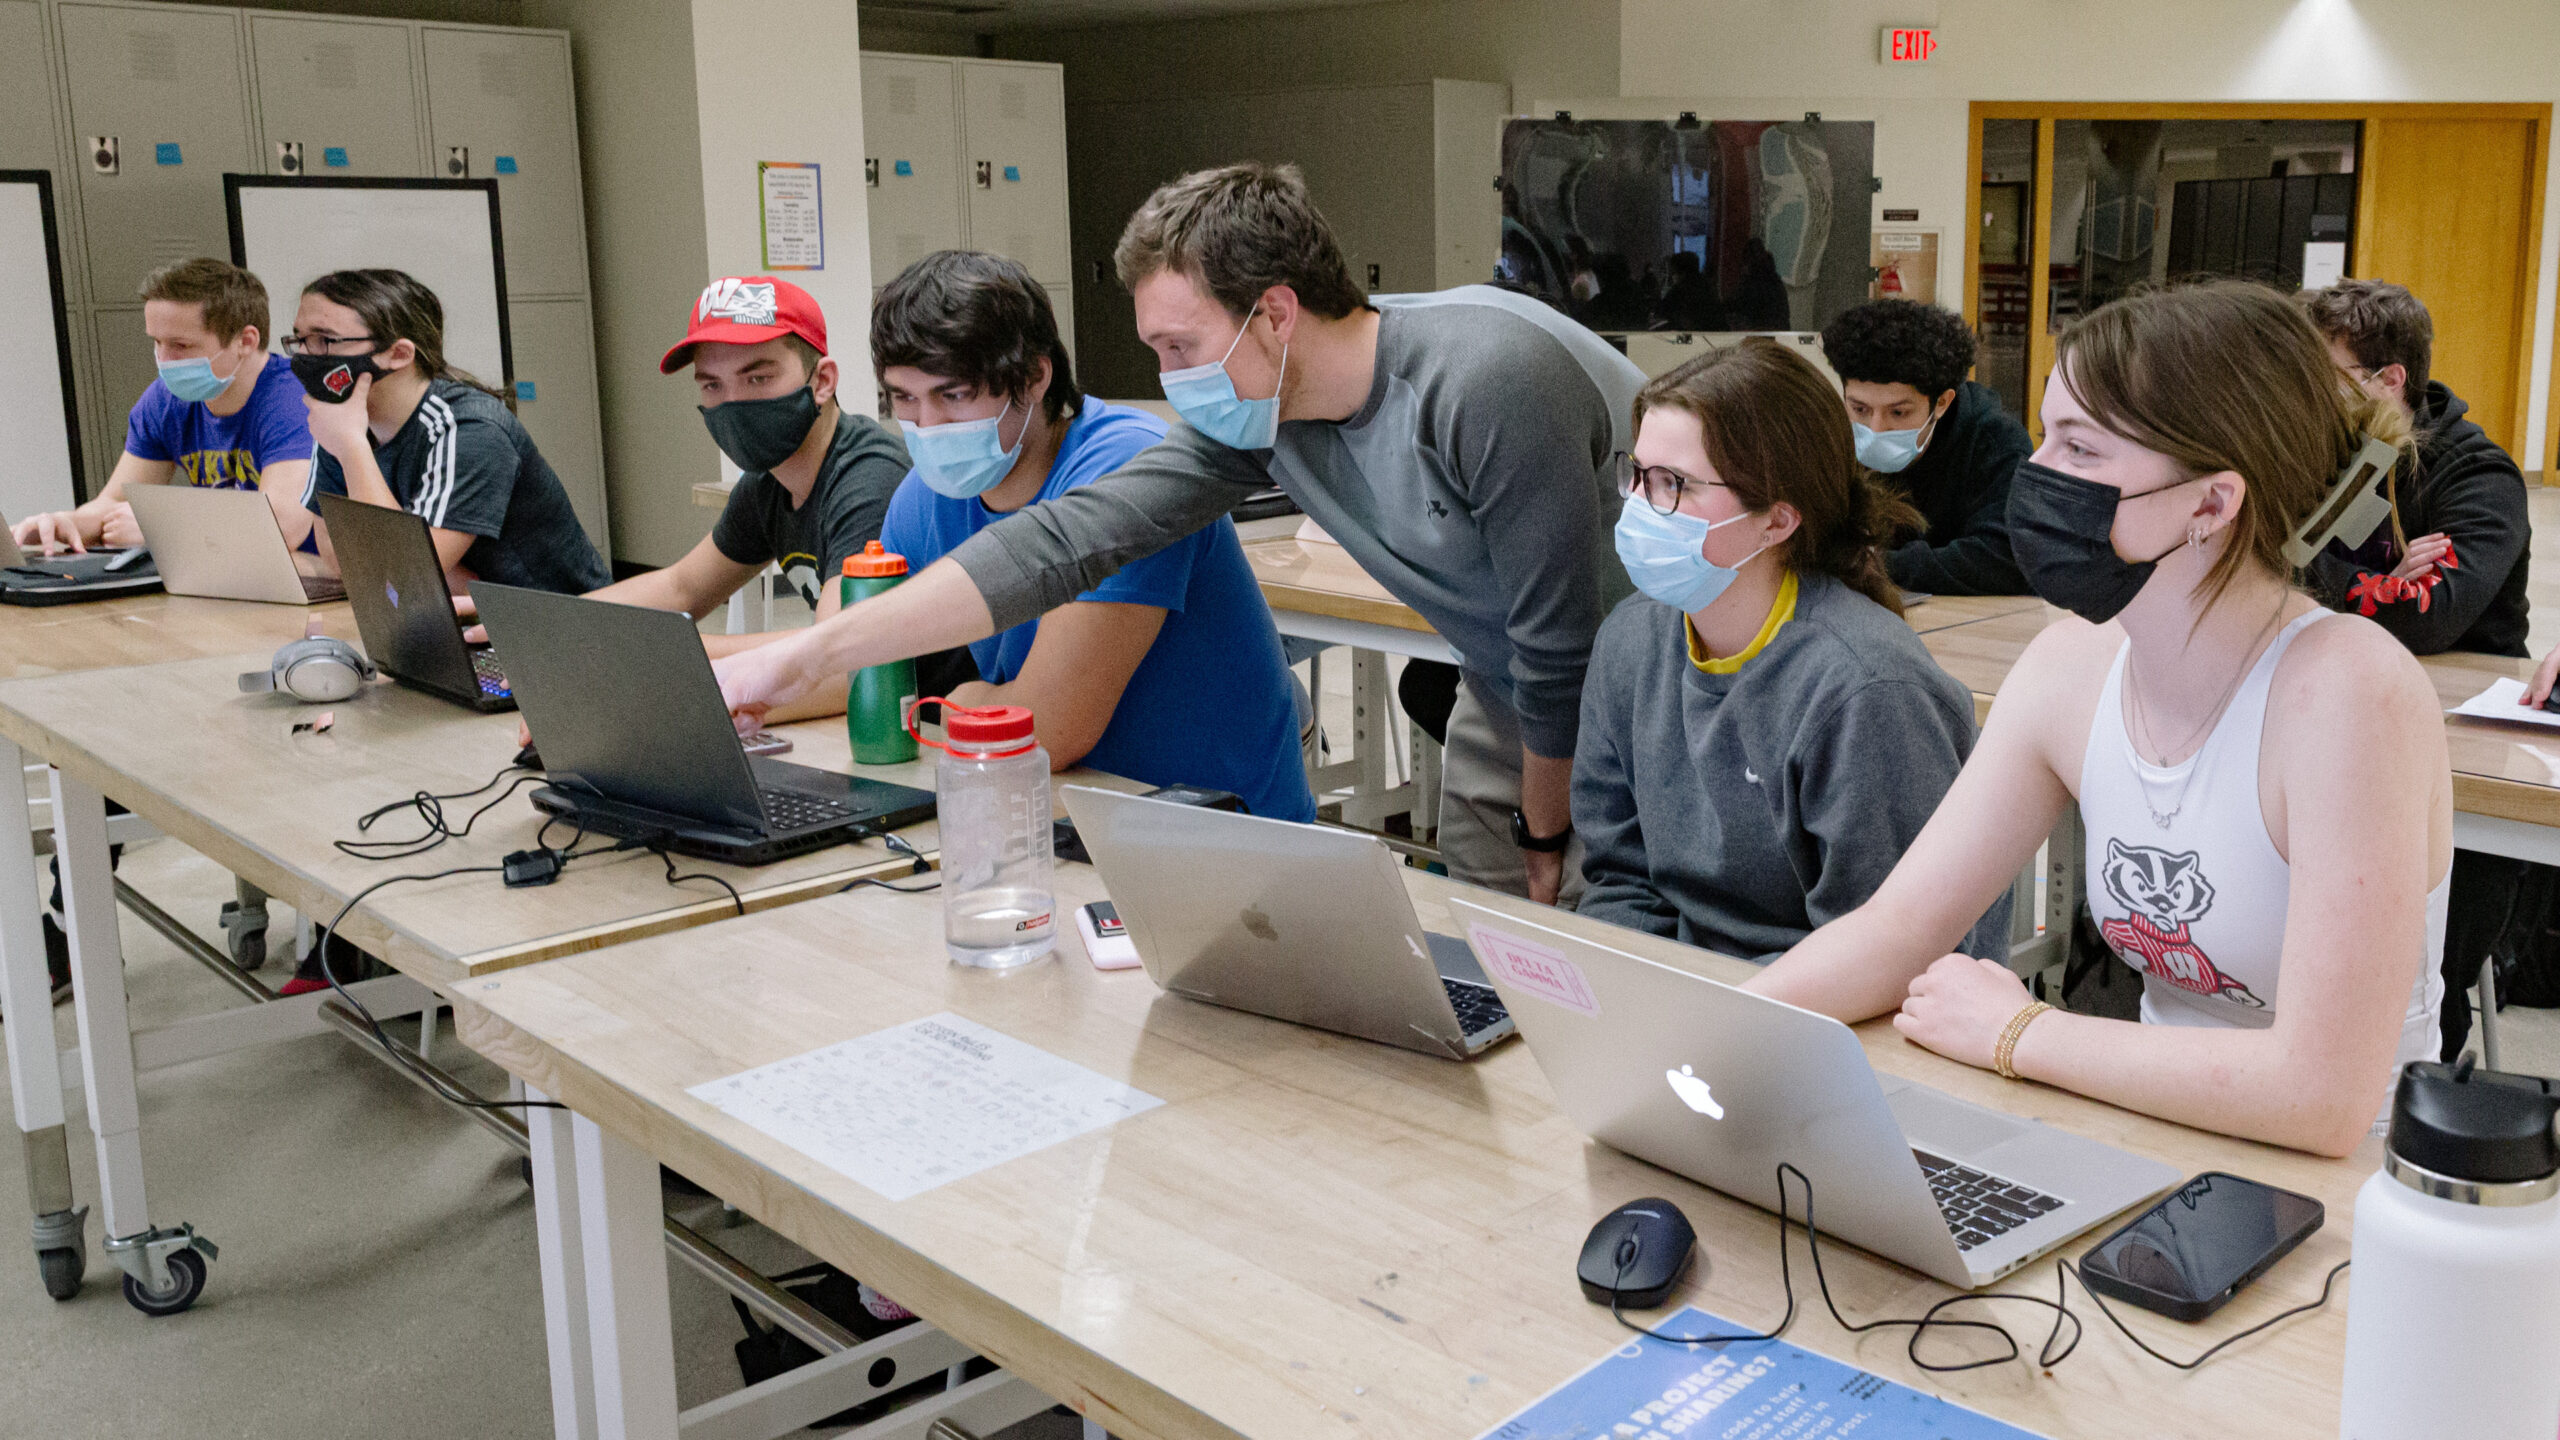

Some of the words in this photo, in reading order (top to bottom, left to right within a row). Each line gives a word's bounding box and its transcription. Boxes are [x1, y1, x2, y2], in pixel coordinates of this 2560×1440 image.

[1892, 29, 1931, 61] EXIT
[1506, 951, 1554, 976] DELTA
[1511, 964, 1565, 991] GAMMA
[1630, 1353, 1737, 1426] PROJECT
[1660, 1355, 1777, 1435] SHARING?
[1721, 1416, 1755, 1440] code
[1753, 1404, 1772, 1416] to
[1773, 1396, 1806, 1423] staff
